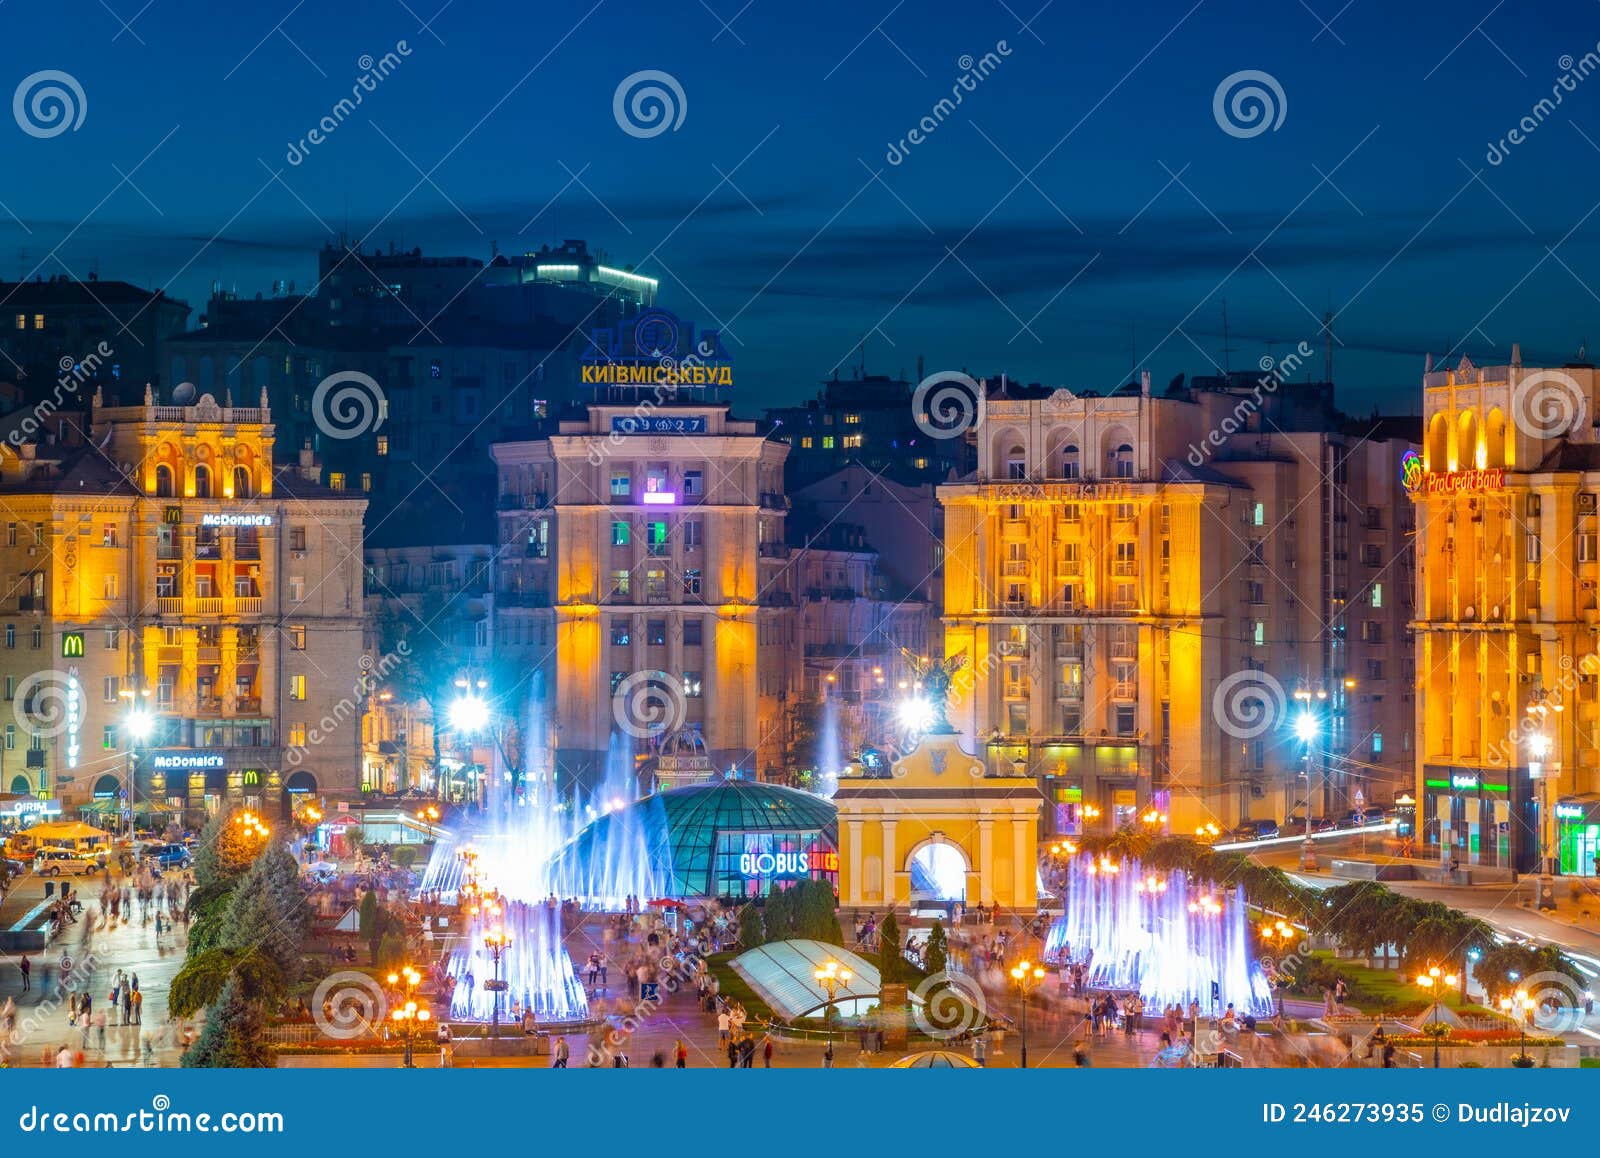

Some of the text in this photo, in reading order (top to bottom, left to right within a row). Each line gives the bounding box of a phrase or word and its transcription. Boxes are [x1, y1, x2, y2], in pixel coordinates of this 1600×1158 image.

[582, 364, 733, 385] КИЇВМІСЬКБУД
[1428, 468, 1503, 492] ProCredit Bank
[203, 513, 272, 526] McDonald's
[154, 755, 224, 767] McDonald's
[740, 852, 809, 874] GLOBUS
